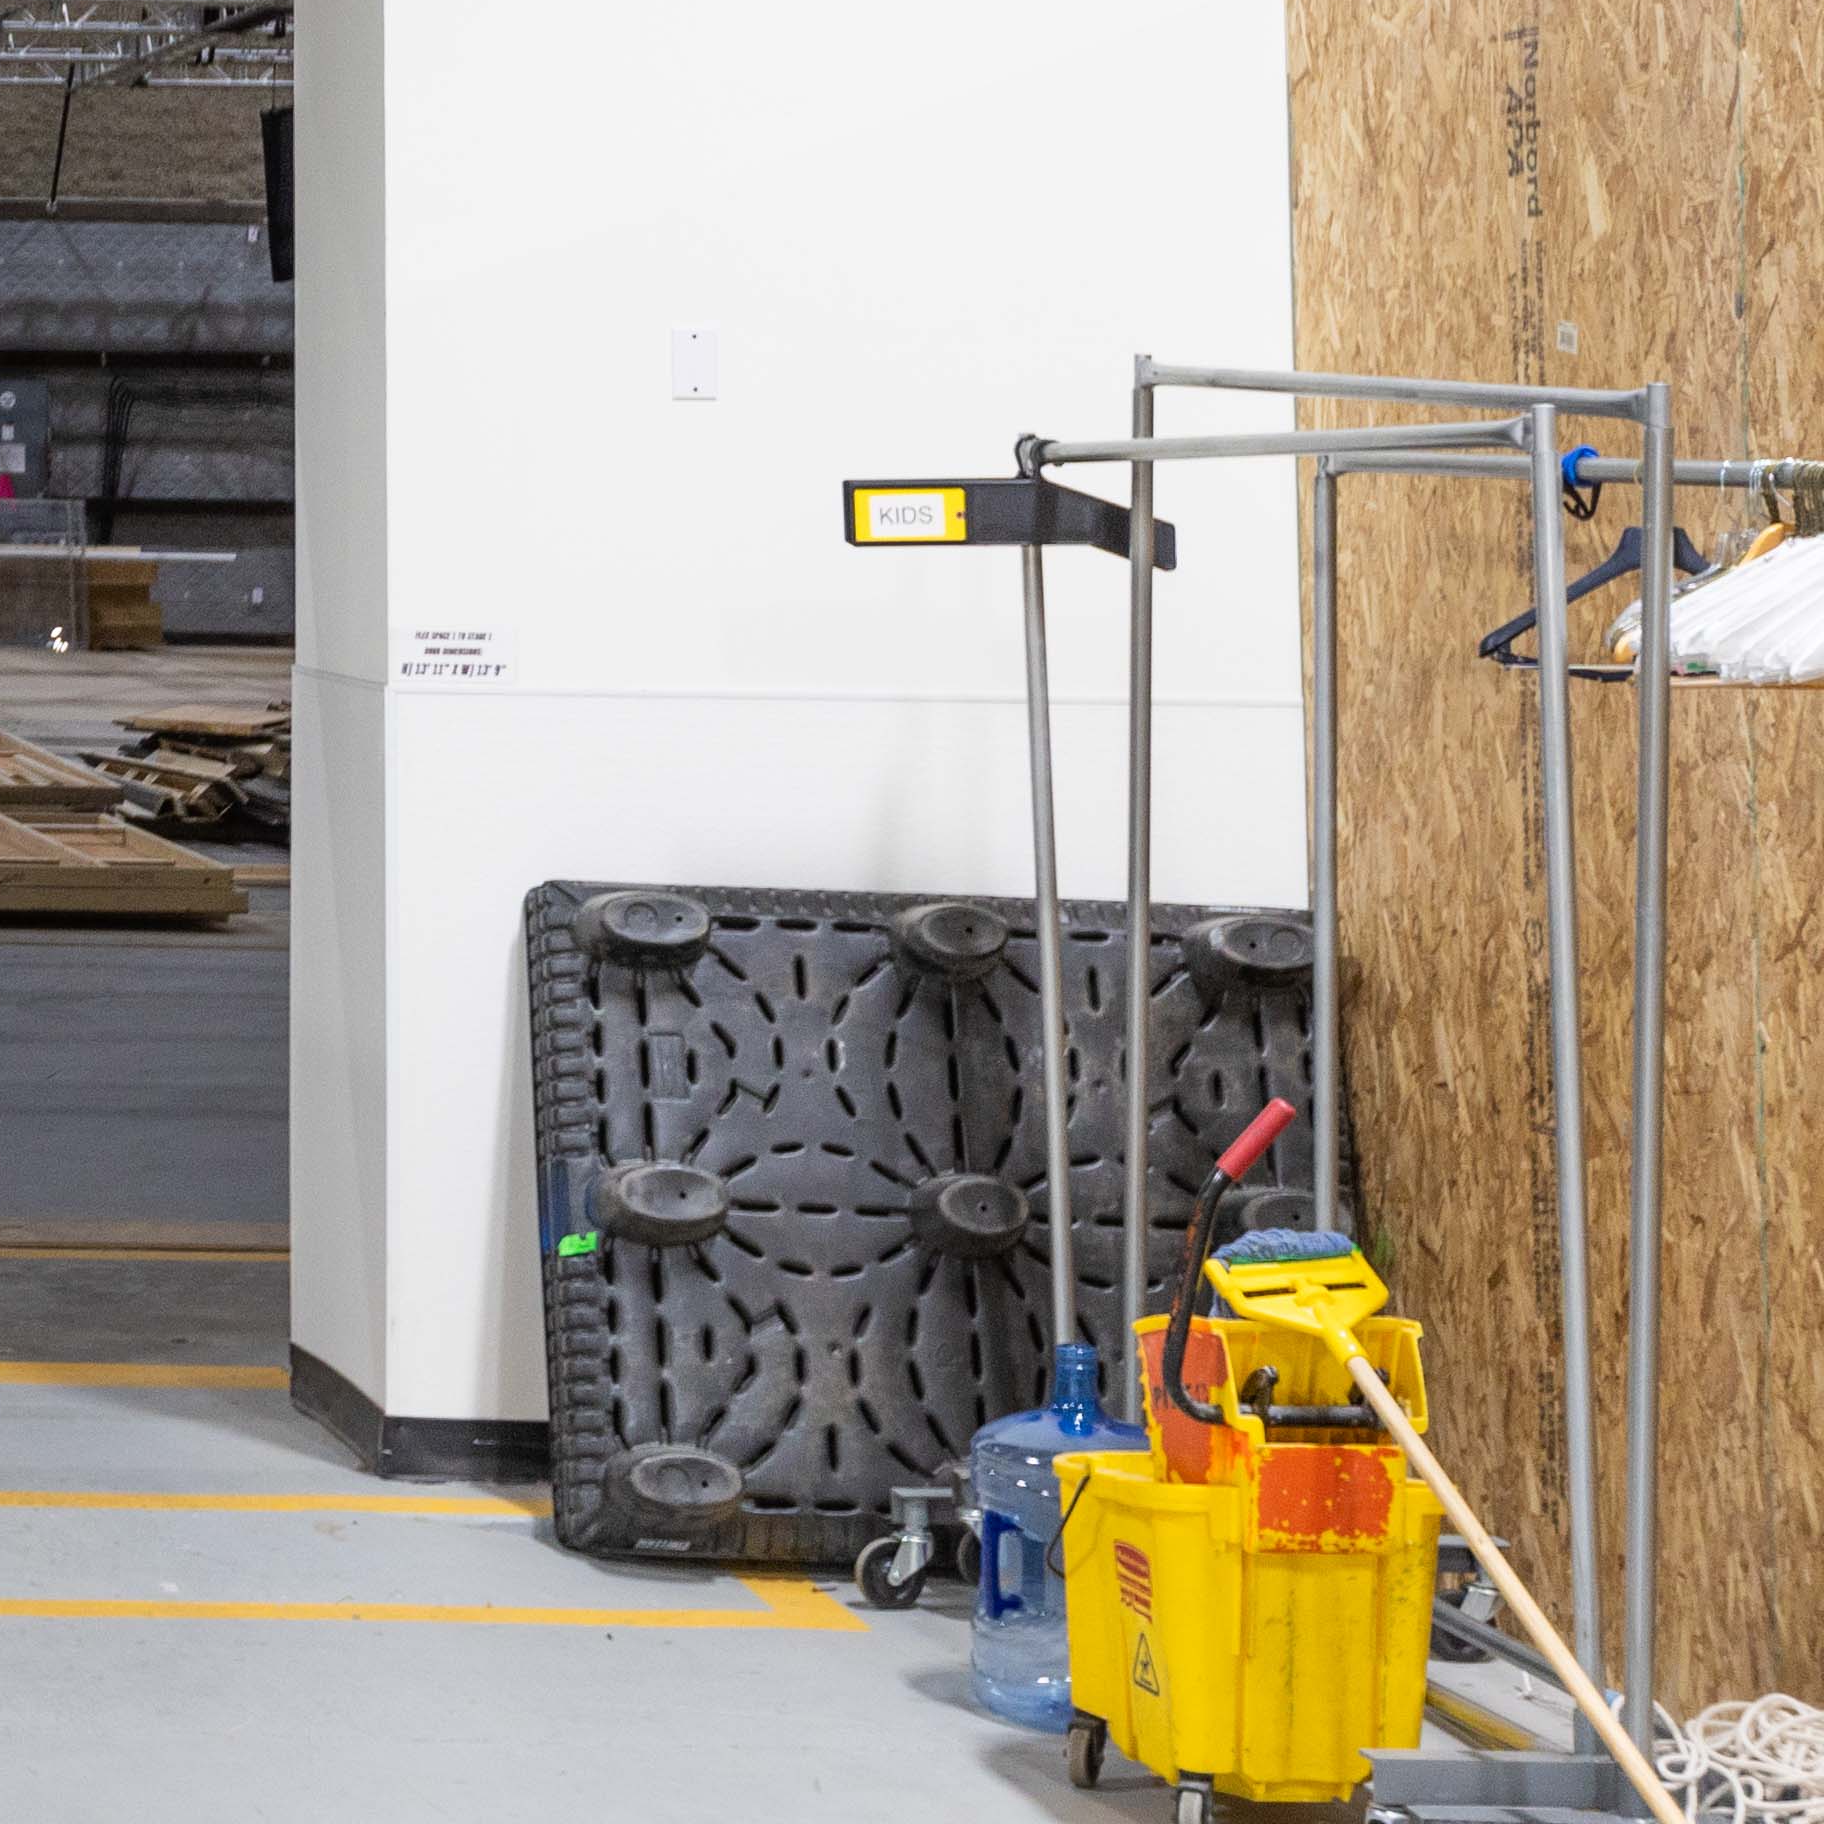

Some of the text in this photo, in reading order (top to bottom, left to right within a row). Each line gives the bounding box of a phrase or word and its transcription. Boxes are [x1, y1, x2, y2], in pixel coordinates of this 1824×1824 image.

[1505, 87, 1522, 178] APA
[1522, 39, 1543, 218] Norbord
[879, 505, 934, 526] KIDS
